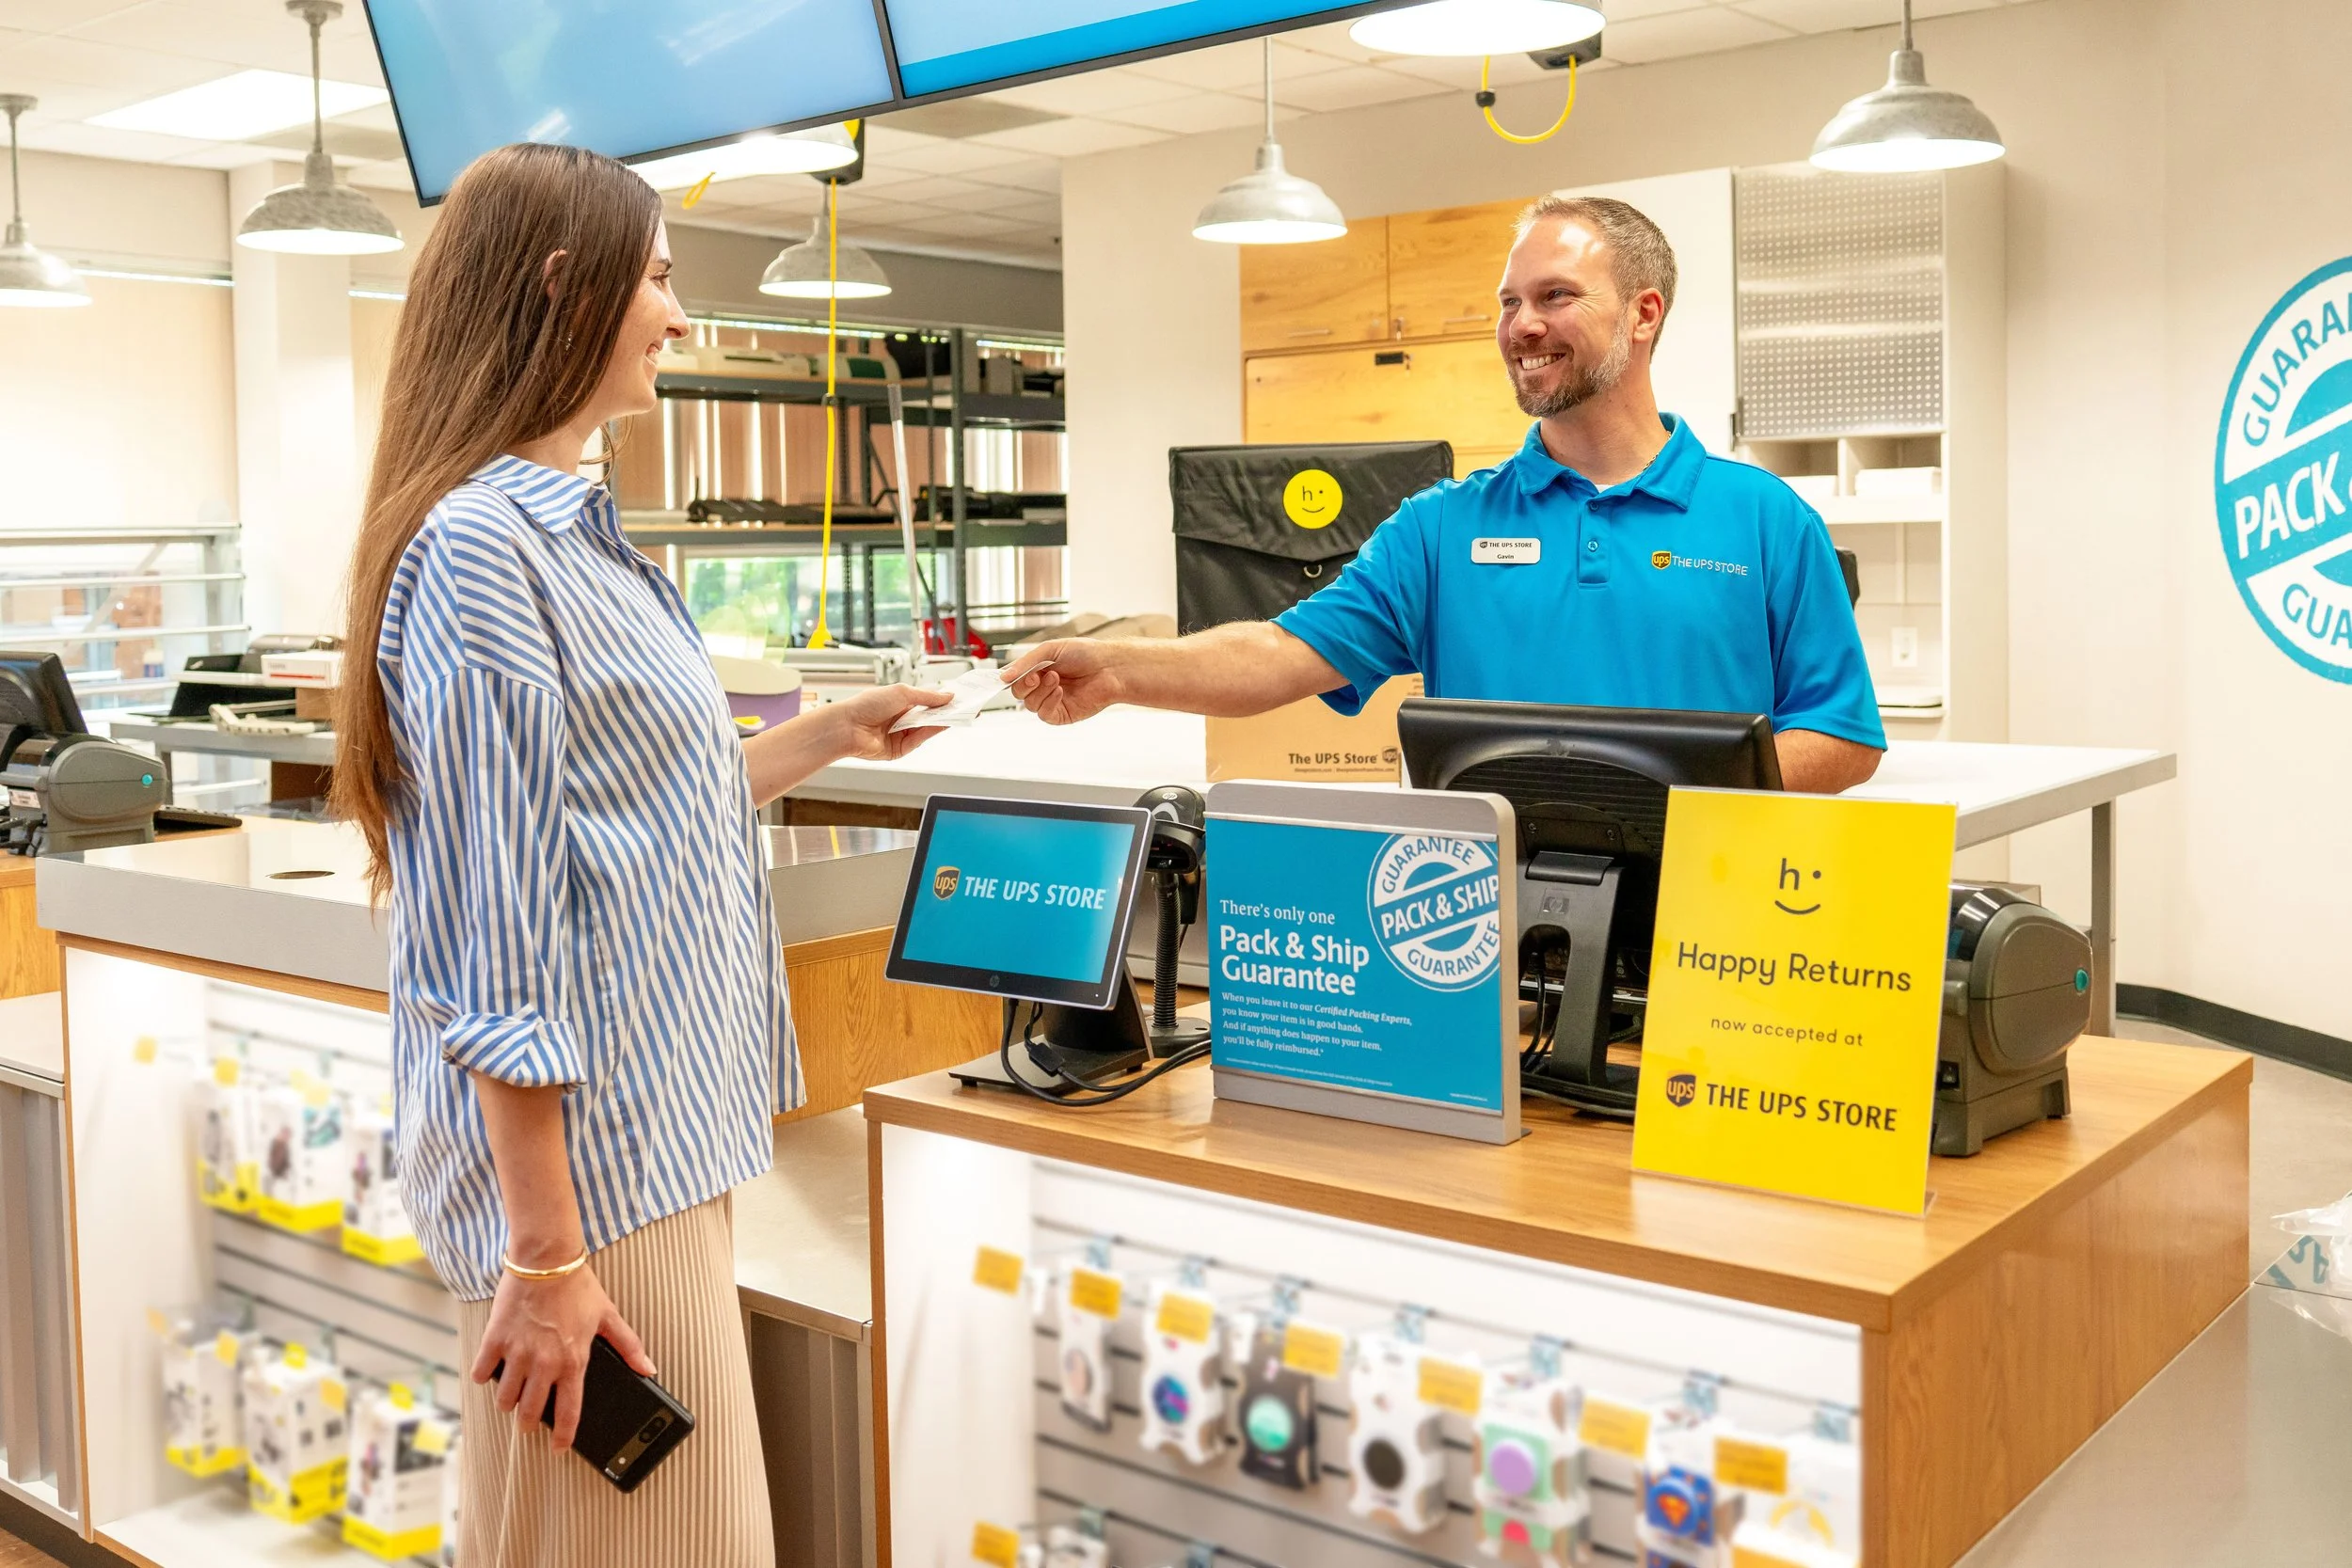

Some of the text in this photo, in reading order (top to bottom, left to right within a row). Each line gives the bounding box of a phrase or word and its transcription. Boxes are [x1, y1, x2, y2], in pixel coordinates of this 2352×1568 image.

[2234, 451, 2345, 560] PACK
[1673, 556, 1748, 576] THE UPS STORE
[1288, 753, 1376, 765] The UPS Store
[1382, 836, 1474, 894] GUARANTEE
[935, 878, 957, 895] ups
[964, 876, 1106, 910] THE UPS STORE
[1219, 899, 1335, 925] There's only one
[1381, 875, 1499, 940] PACK & SHIP
[1219, 925, 1370, 973] Pack & Ship
[1407, 920, 1500, 976] GUARANTEE
[1221, 955, 1356, 996] Guarantee
[1677, 941, 1912, 992] Happy Returns
[1222, 991, 1245, 1003] When
[1246, 996, 1260, 1006] you
[1262, 996, 1280, 1007] leave
[1282, 1000, 1288, 1008] it
[1299, 1004, 1312, 1012] our
[1314, 1004, 1348, 1017] Certified
[1348, 1008, 1380, 1023] Packing
[1380, 1013, 1413, 1026] Experts,
[1222, 1007, 1363, 1033] you know your item is in good hands.
[1222, 1021, 1383, 1051] And if anything does happen to your item.
[1223, 1035, 1245, 1044] you'll
[1246, 1037, 1255, 1046] be
[1256, 1037, 1274, 1051] fully
[1710, 1017, 1864, 1046] now accepted at
[1667, 1080, 1694, 1104] ups
[1707, 1083, 1898, 1132] THE UPS STORE
